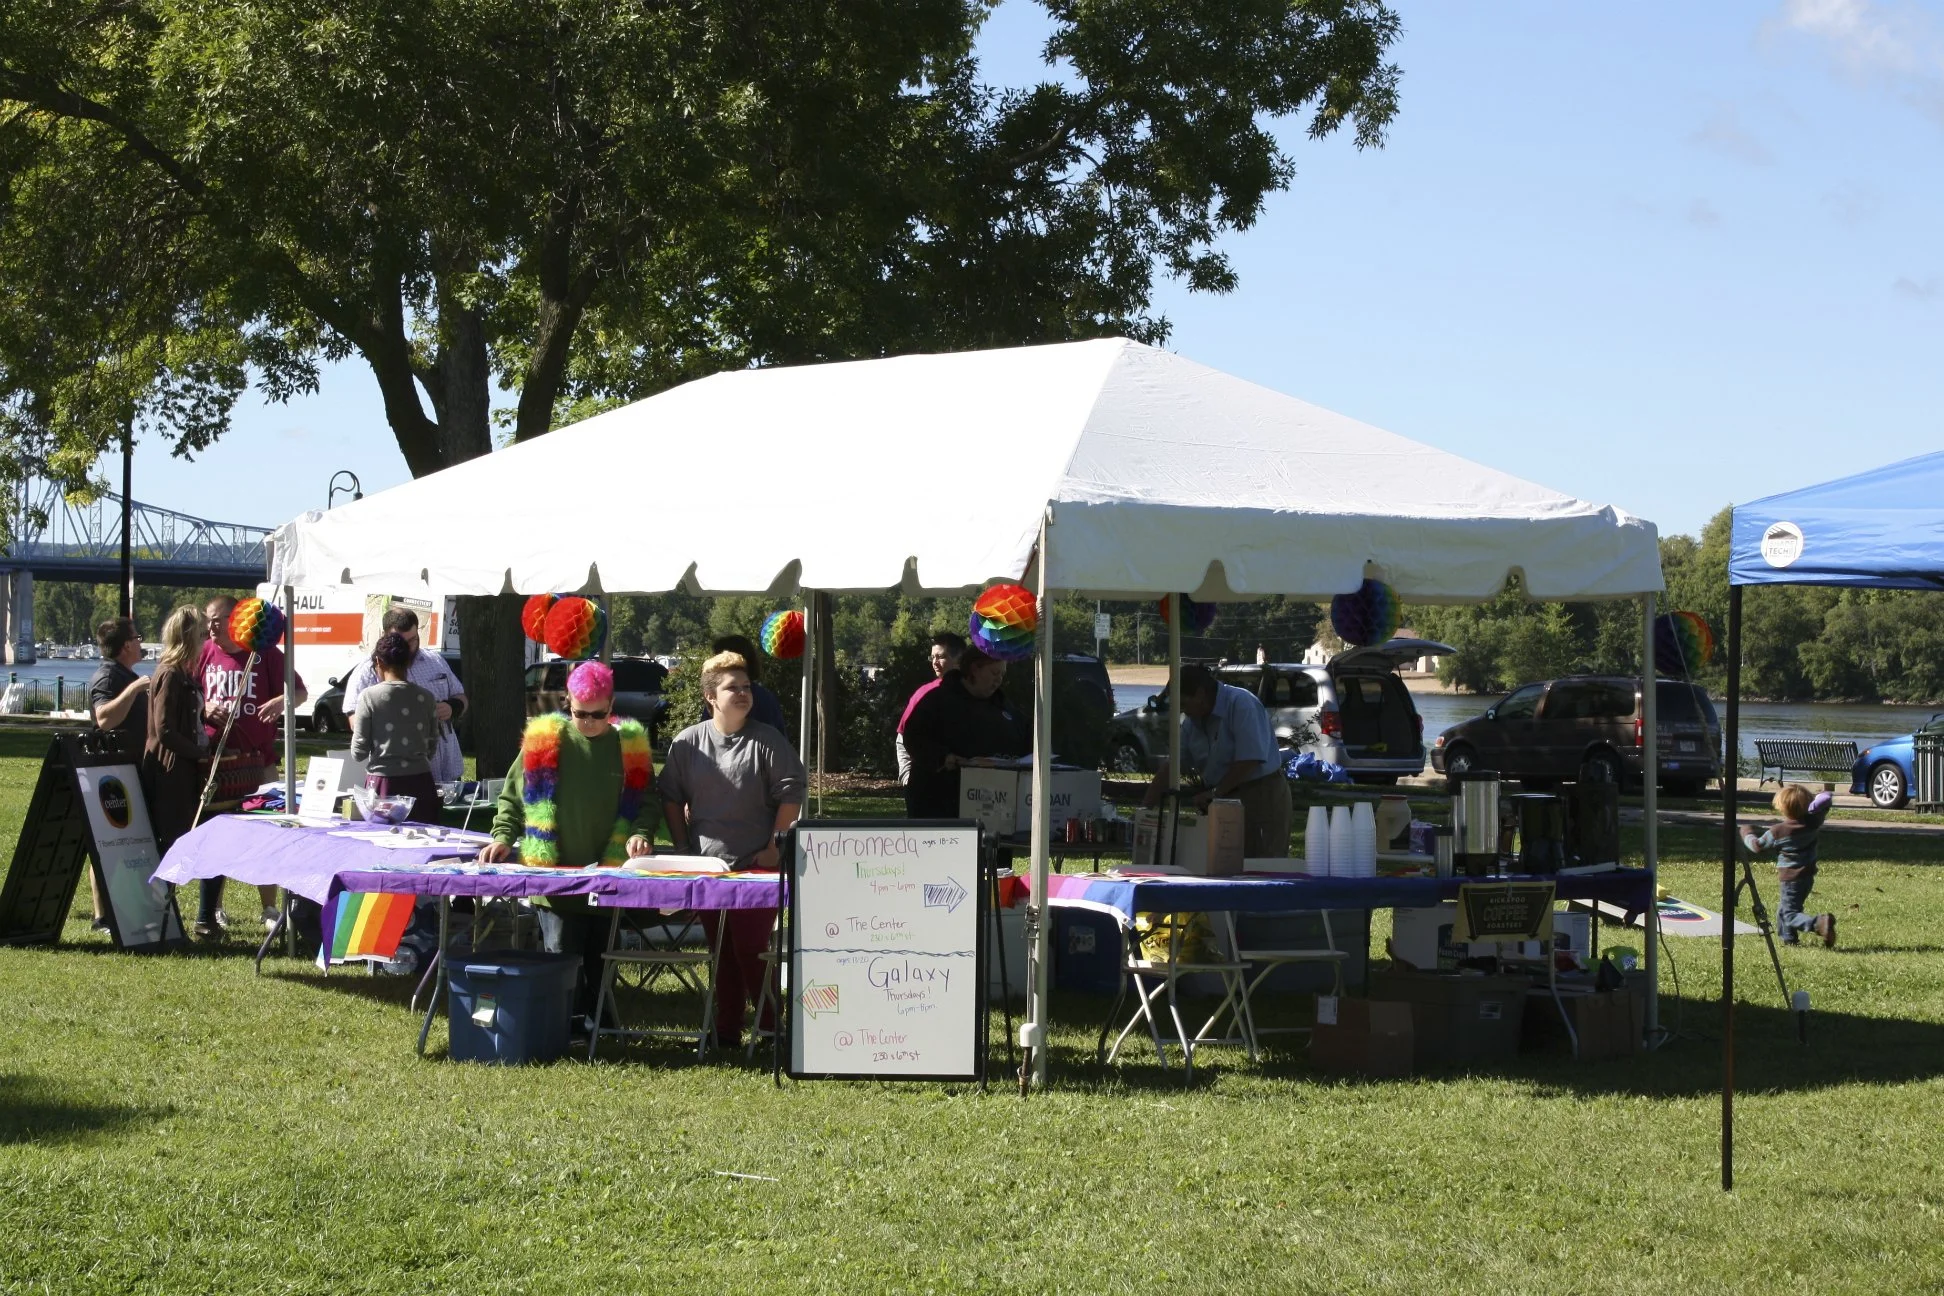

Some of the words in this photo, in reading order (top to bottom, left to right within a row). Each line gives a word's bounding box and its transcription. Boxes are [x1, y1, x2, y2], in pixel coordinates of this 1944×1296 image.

[205, 670, 258, 700] PRIDE
[104, 798, 127, 809] center
[802, 831, 920, 875] Andromeda
[939, 837, 960, 845] 18-25
[852, 861, 906, 879] Thursdays!
[1483, 904, 1529, 922] COFFEE
[846, 916, 868, 932] The
[870, 916, 908, 931] Center
[868, 956, 950, 992] Galaxy
[883, 988, 932, 1002] Thursdays!
[857, 1028, 877, 1046] The
[879, 1028, 907, 1045] Center
